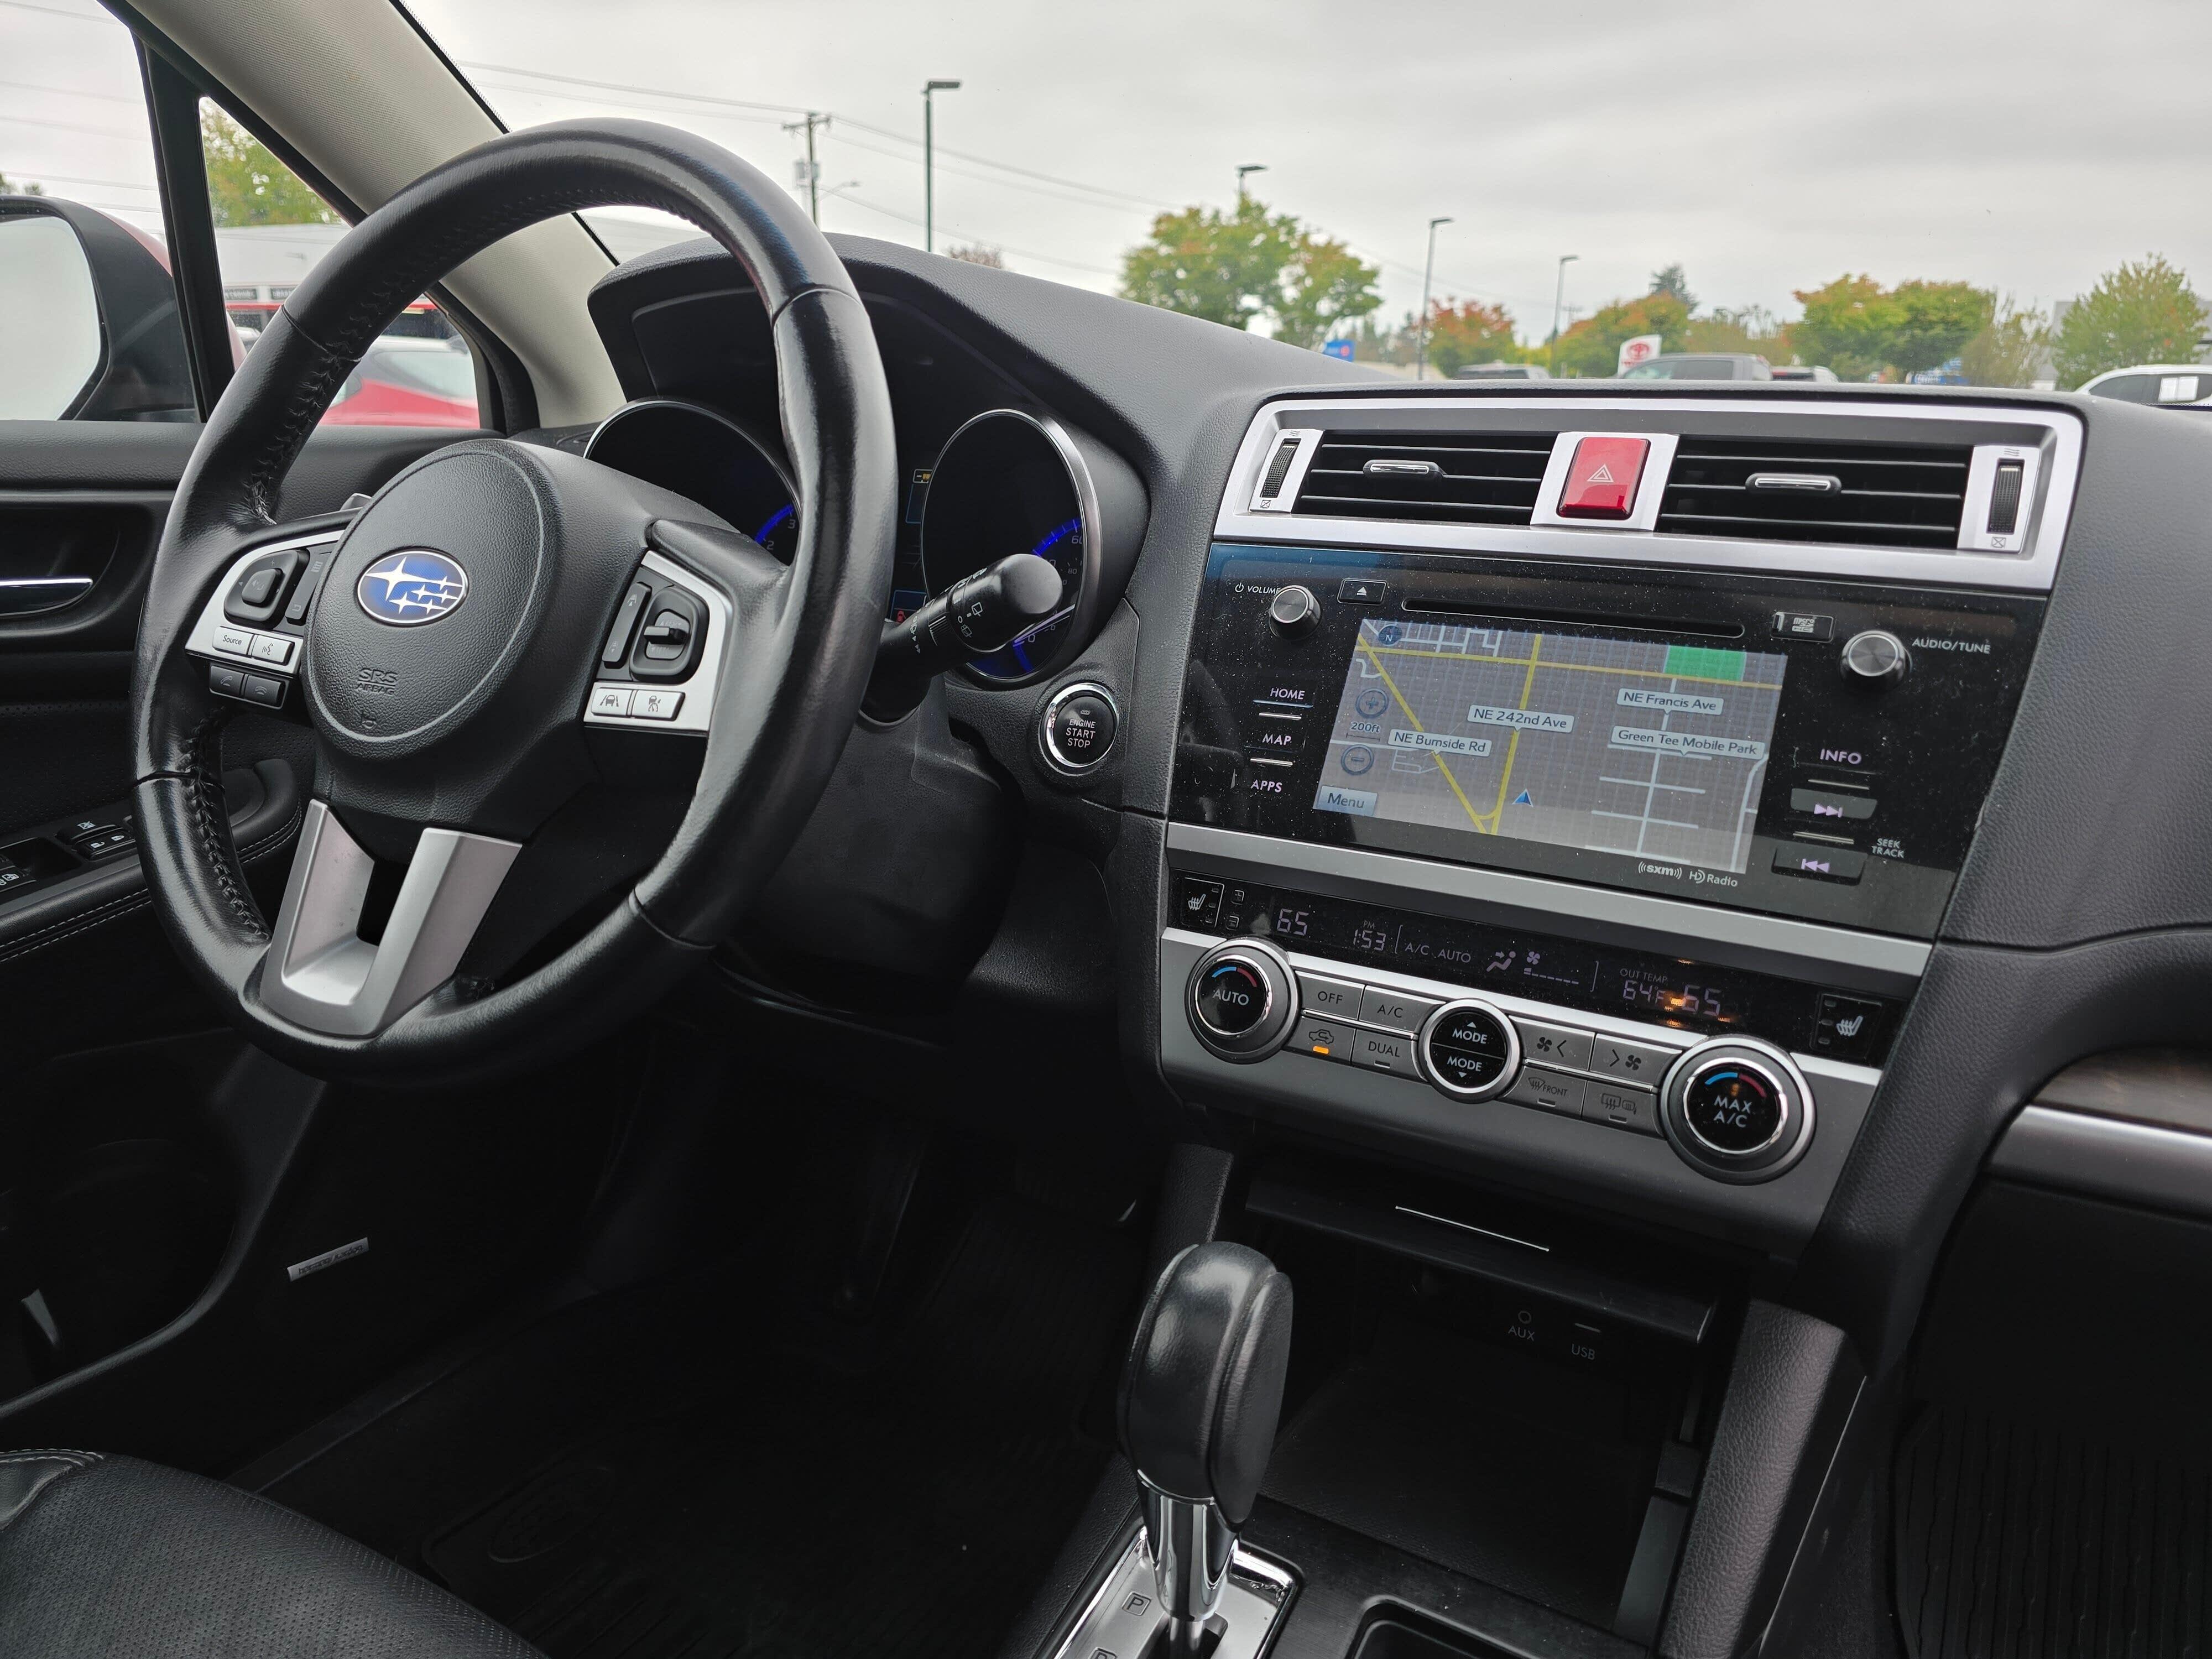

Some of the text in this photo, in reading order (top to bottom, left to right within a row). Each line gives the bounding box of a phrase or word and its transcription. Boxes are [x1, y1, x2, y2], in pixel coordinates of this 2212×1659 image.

[787, 519, 796, 529] 3
[766, 540, 775, 550] 2
[1248, 585, 1281, 594] VOLUME
[222, 634, 242, 645] Source
[1385, 634, 1393, 642] N
[1912, 637, 1991, 655] AUDIO/TUNE
[358, 667, 398, 684] SRS
[1270, 687, 1305, 700] HOME
[1623, 691, 1717, 711] NE Francis Ave
[1069, 718, 1096, 729] ENGINE
[1474, 708, 1567, 728] NE 242nd Ave
[1066, 727, 1095, 739] START
[1350, 722, 1380, 733] 200ft
[1067, 737, 1091, 748] STOP
[1262, 733, 1291, 745] MAP
[1394, 732, 1486, 753] NE Burnside Rd
[1618, 729, 1757, 755] Green Tee Mobile Park
[1820, 748, 1862, 765] INFO
[1250, 779, 1282, 793] APPS
[1327, 792, 1365, 808] Menu
[1877, 838, 1901, 849] SEEK
[1871, 846, 1905, 858] TRACK
[1707, 874, 1738, 887] Radio
[1276, 907, 1310, 936] 65
[1363, 920, 1375, 930] PM
[1353, 928, 1386, 951] 1:53
[1405, 942, 1472, 963] A/C AUTO
[1619, 968, 1668, 984] OUT TEMP
[1212, 987, 1249, 1006] AUTO
[1317, 990, 1344, 1005] OFF
[1682, 984, 1722, 1016] 65
[1377, 1004, 1404, 1019] A/C
[1452, 1028, 1488, 1045] MODE
[1368, 1040, 1401, 1058] DUAL
[1446, 1055, 1482, 1072] MODE
[1543, 1086, 1568, 1098] FRONT
[1713, 1094, 1752, 1113] MAX
[1713, 1110, 1747, 1128] A/C
[1507, 1325, 1535, 1341] AUX
[1571, 1343, 1596, 1360] USB
[1126, 1597, 1145, 1610] P
